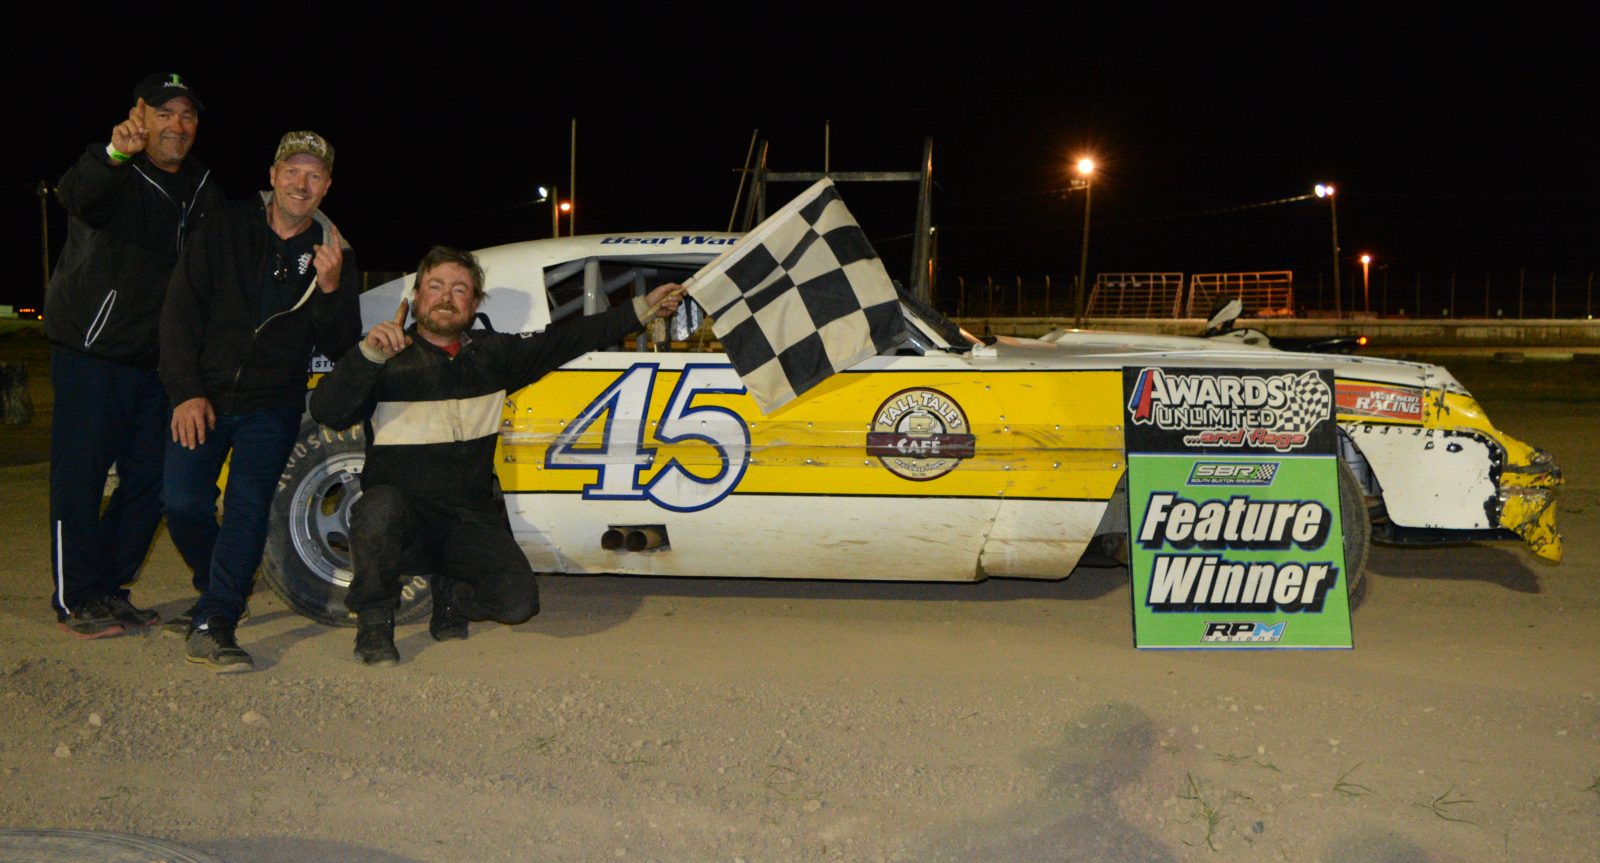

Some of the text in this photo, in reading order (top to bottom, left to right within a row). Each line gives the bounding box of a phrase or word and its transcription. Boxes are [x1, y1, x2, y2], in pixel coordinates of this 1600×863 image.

[600, 236, 675, 245] Bear
[1131, 368, 1288, 409] AWARDS
[1369, 390, 1420, 403] Watson
[877, 391, 962, 429] TALL TALES
[1355, 397, 1421, 414] RACING
[1157, 406, 1278, 428] UNLIMITED
[544, 362, 752, 513] 45
[896, 437, 942, 454] CAFÉ
[1249, 428, 1308, 449] flags
[1196, 465, 1256, 477] SBR
[1137, 491, 1331, 547] Feature
[1146, 554, 1335, 609] Winner
[1205, 622, 1286, 637] RPM
